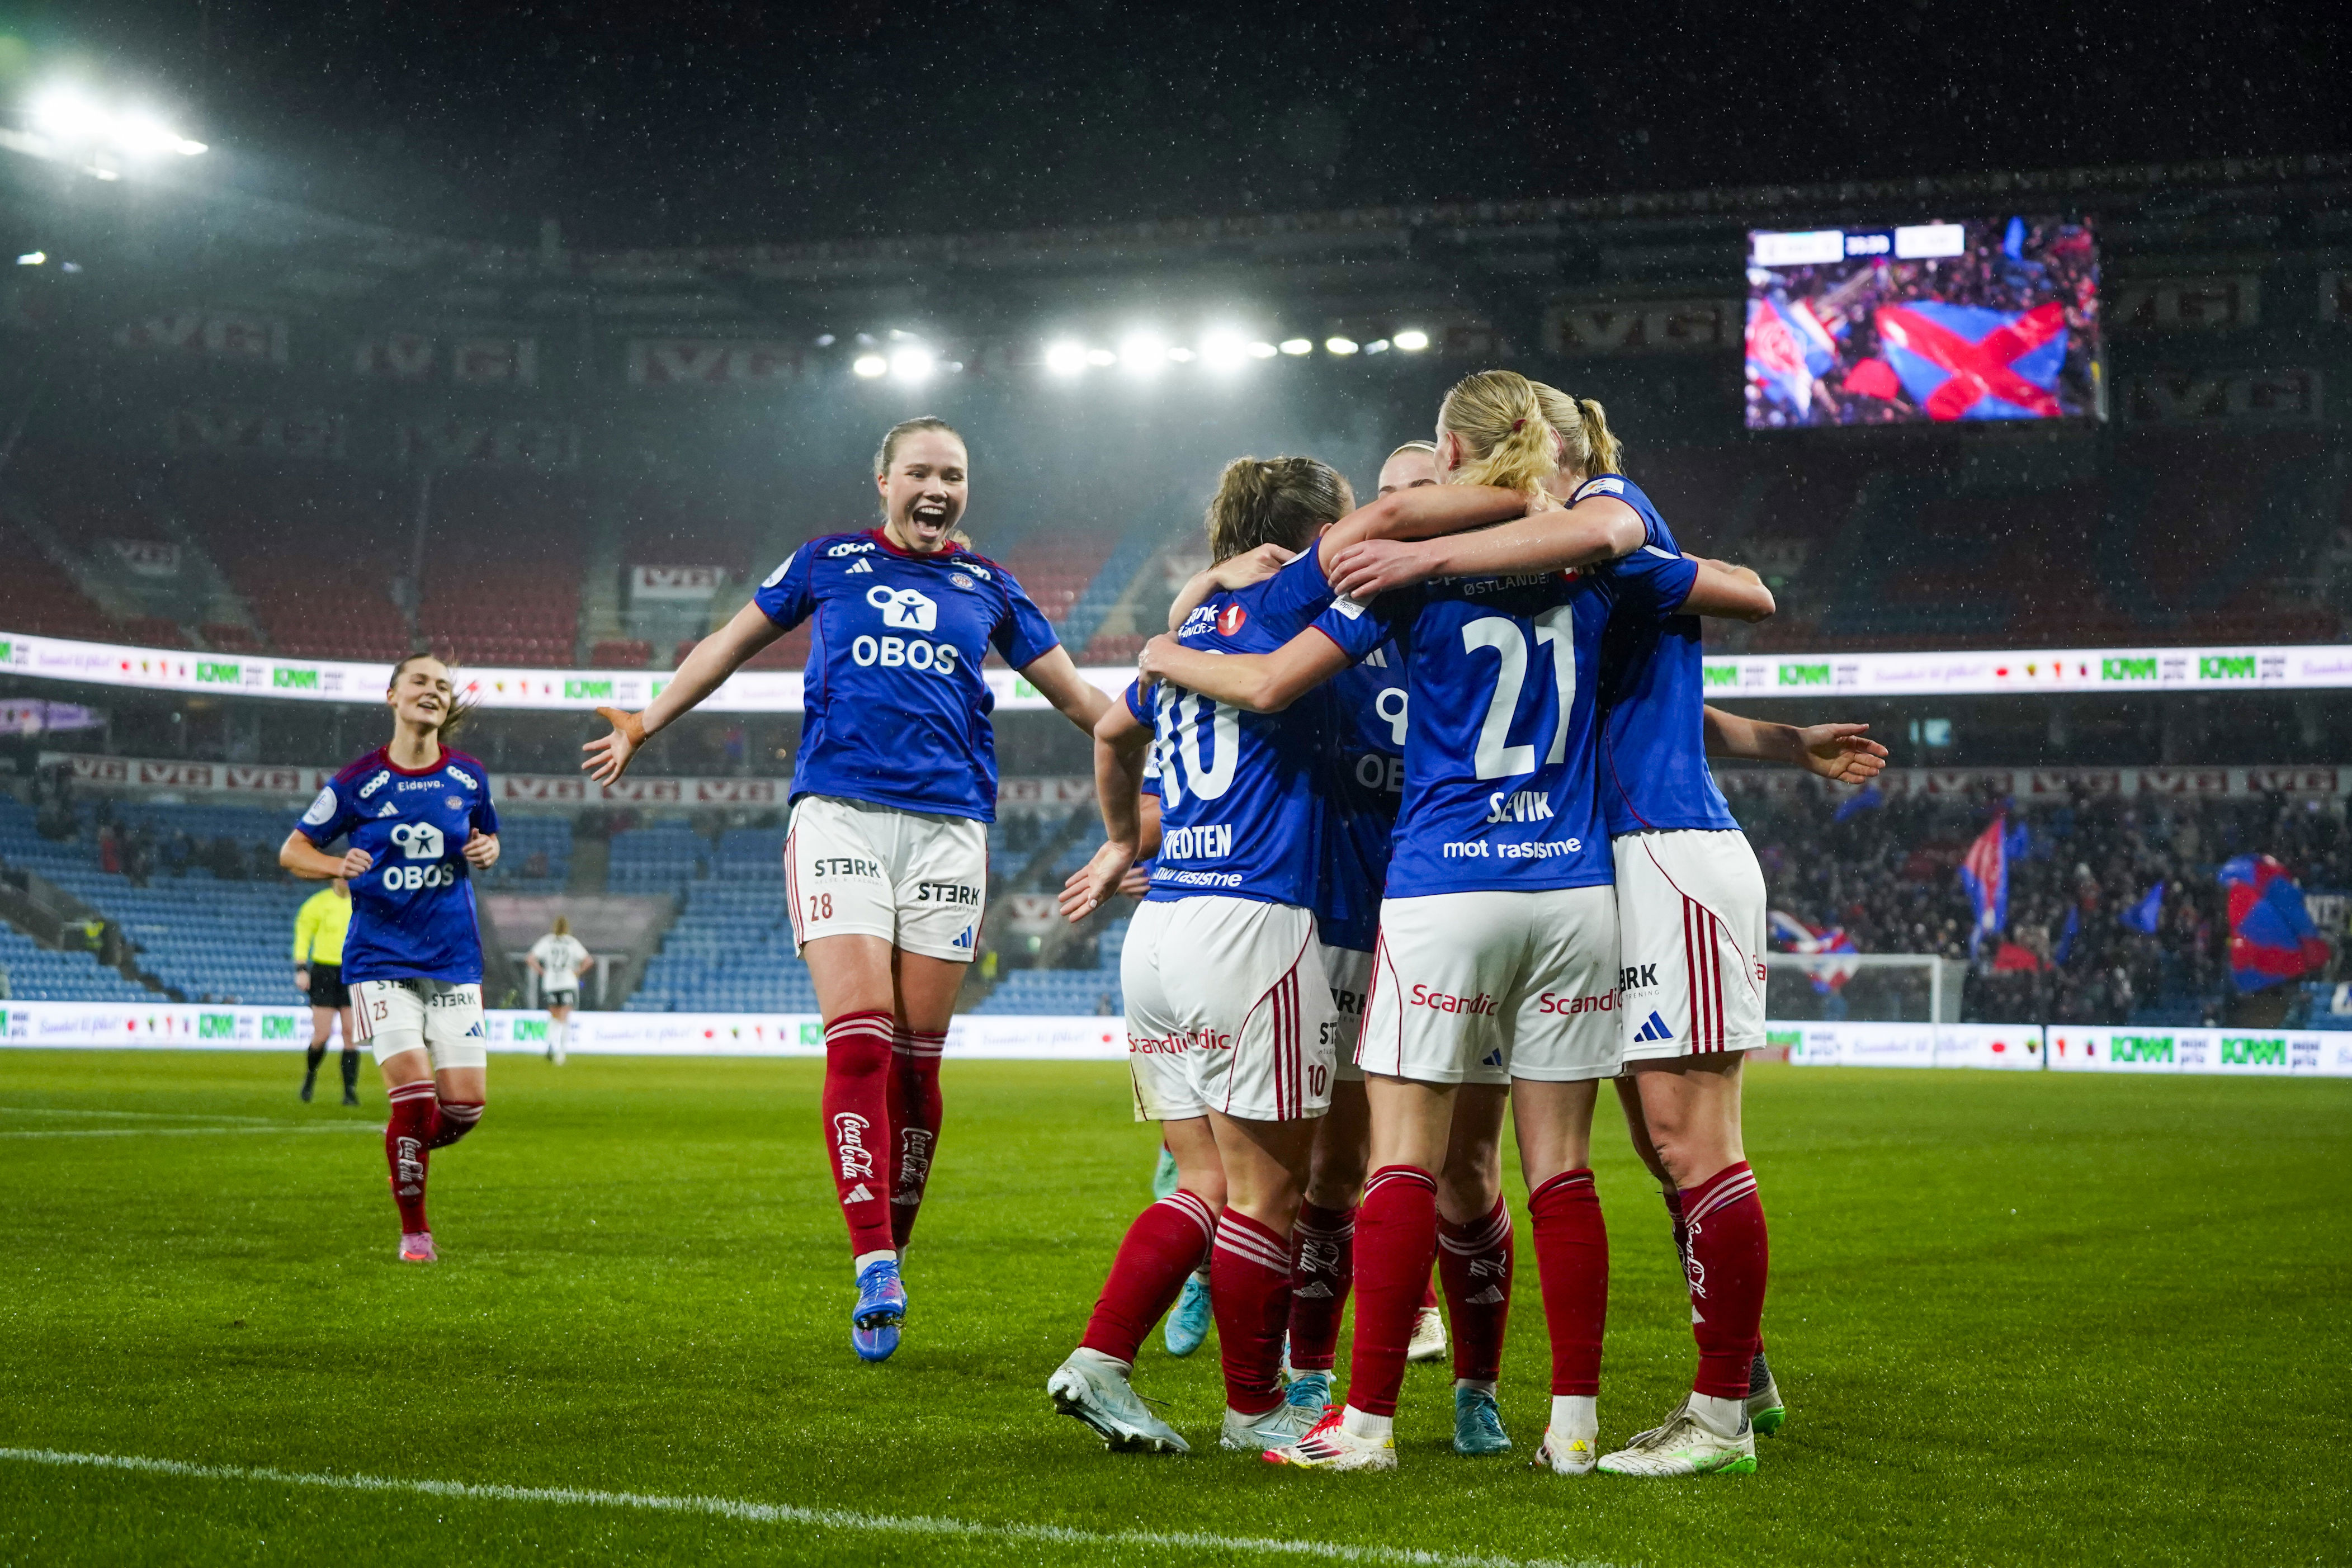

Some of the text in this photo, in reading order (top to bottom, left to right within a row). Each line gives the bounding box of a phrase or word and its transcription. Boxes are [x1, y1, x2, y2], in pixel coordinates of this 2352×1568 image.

[852, 635, 958, 674] OBOS
[1462, 604, 1576, 780] 21
[1443, 838, 1581, 859] mot rasisme
[382, 863, 454, 891] OBOS
[1174, 870, 1243, 887] rasisme
[810, 892, 833, 922] 28
[374, 1000, 388, 1021] 23
[1411, 984, 1499, 1016] Scandic
[1308, 1065, 1327, 1098] 10
